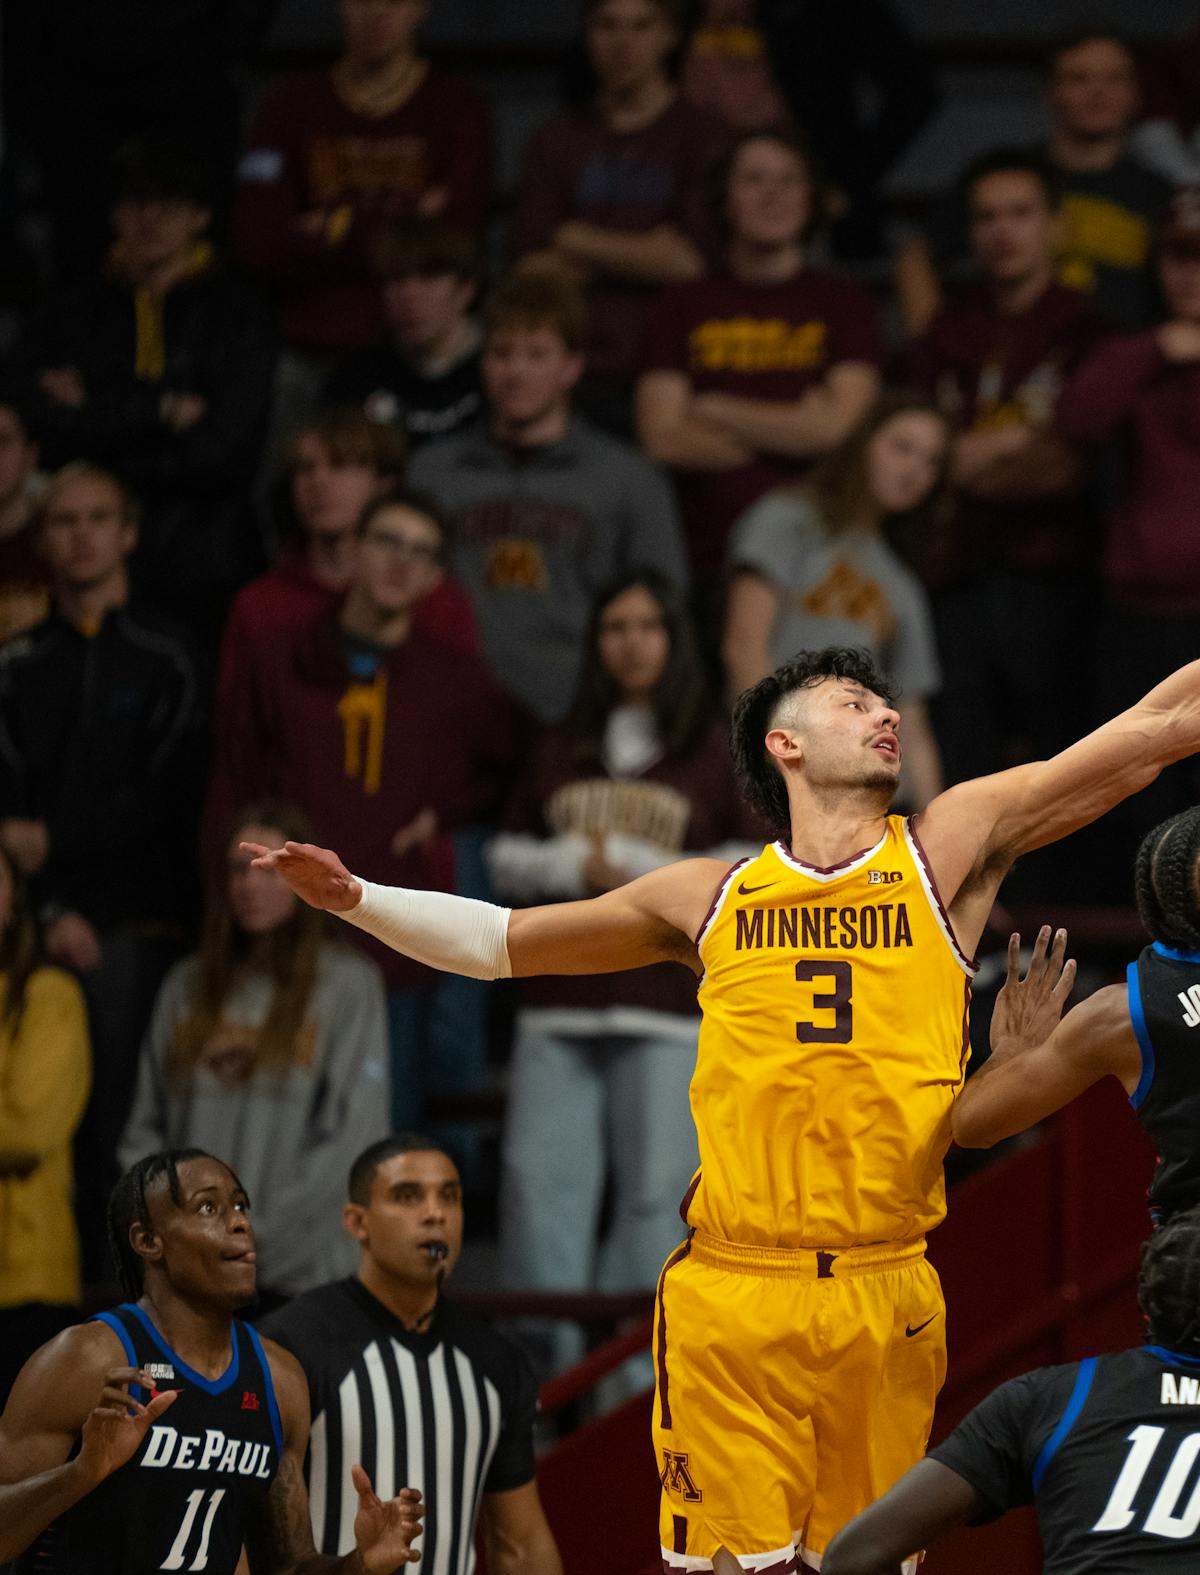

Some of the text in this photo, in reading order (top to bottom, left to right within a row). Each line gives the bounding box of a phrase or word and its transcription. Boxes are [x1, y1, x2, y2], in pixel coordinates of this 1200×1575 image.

[736, 903, 913, 950] MINNESOTA
[795, 959, 853, 1044] 3
[158, 1488, 227, 1571] 11
